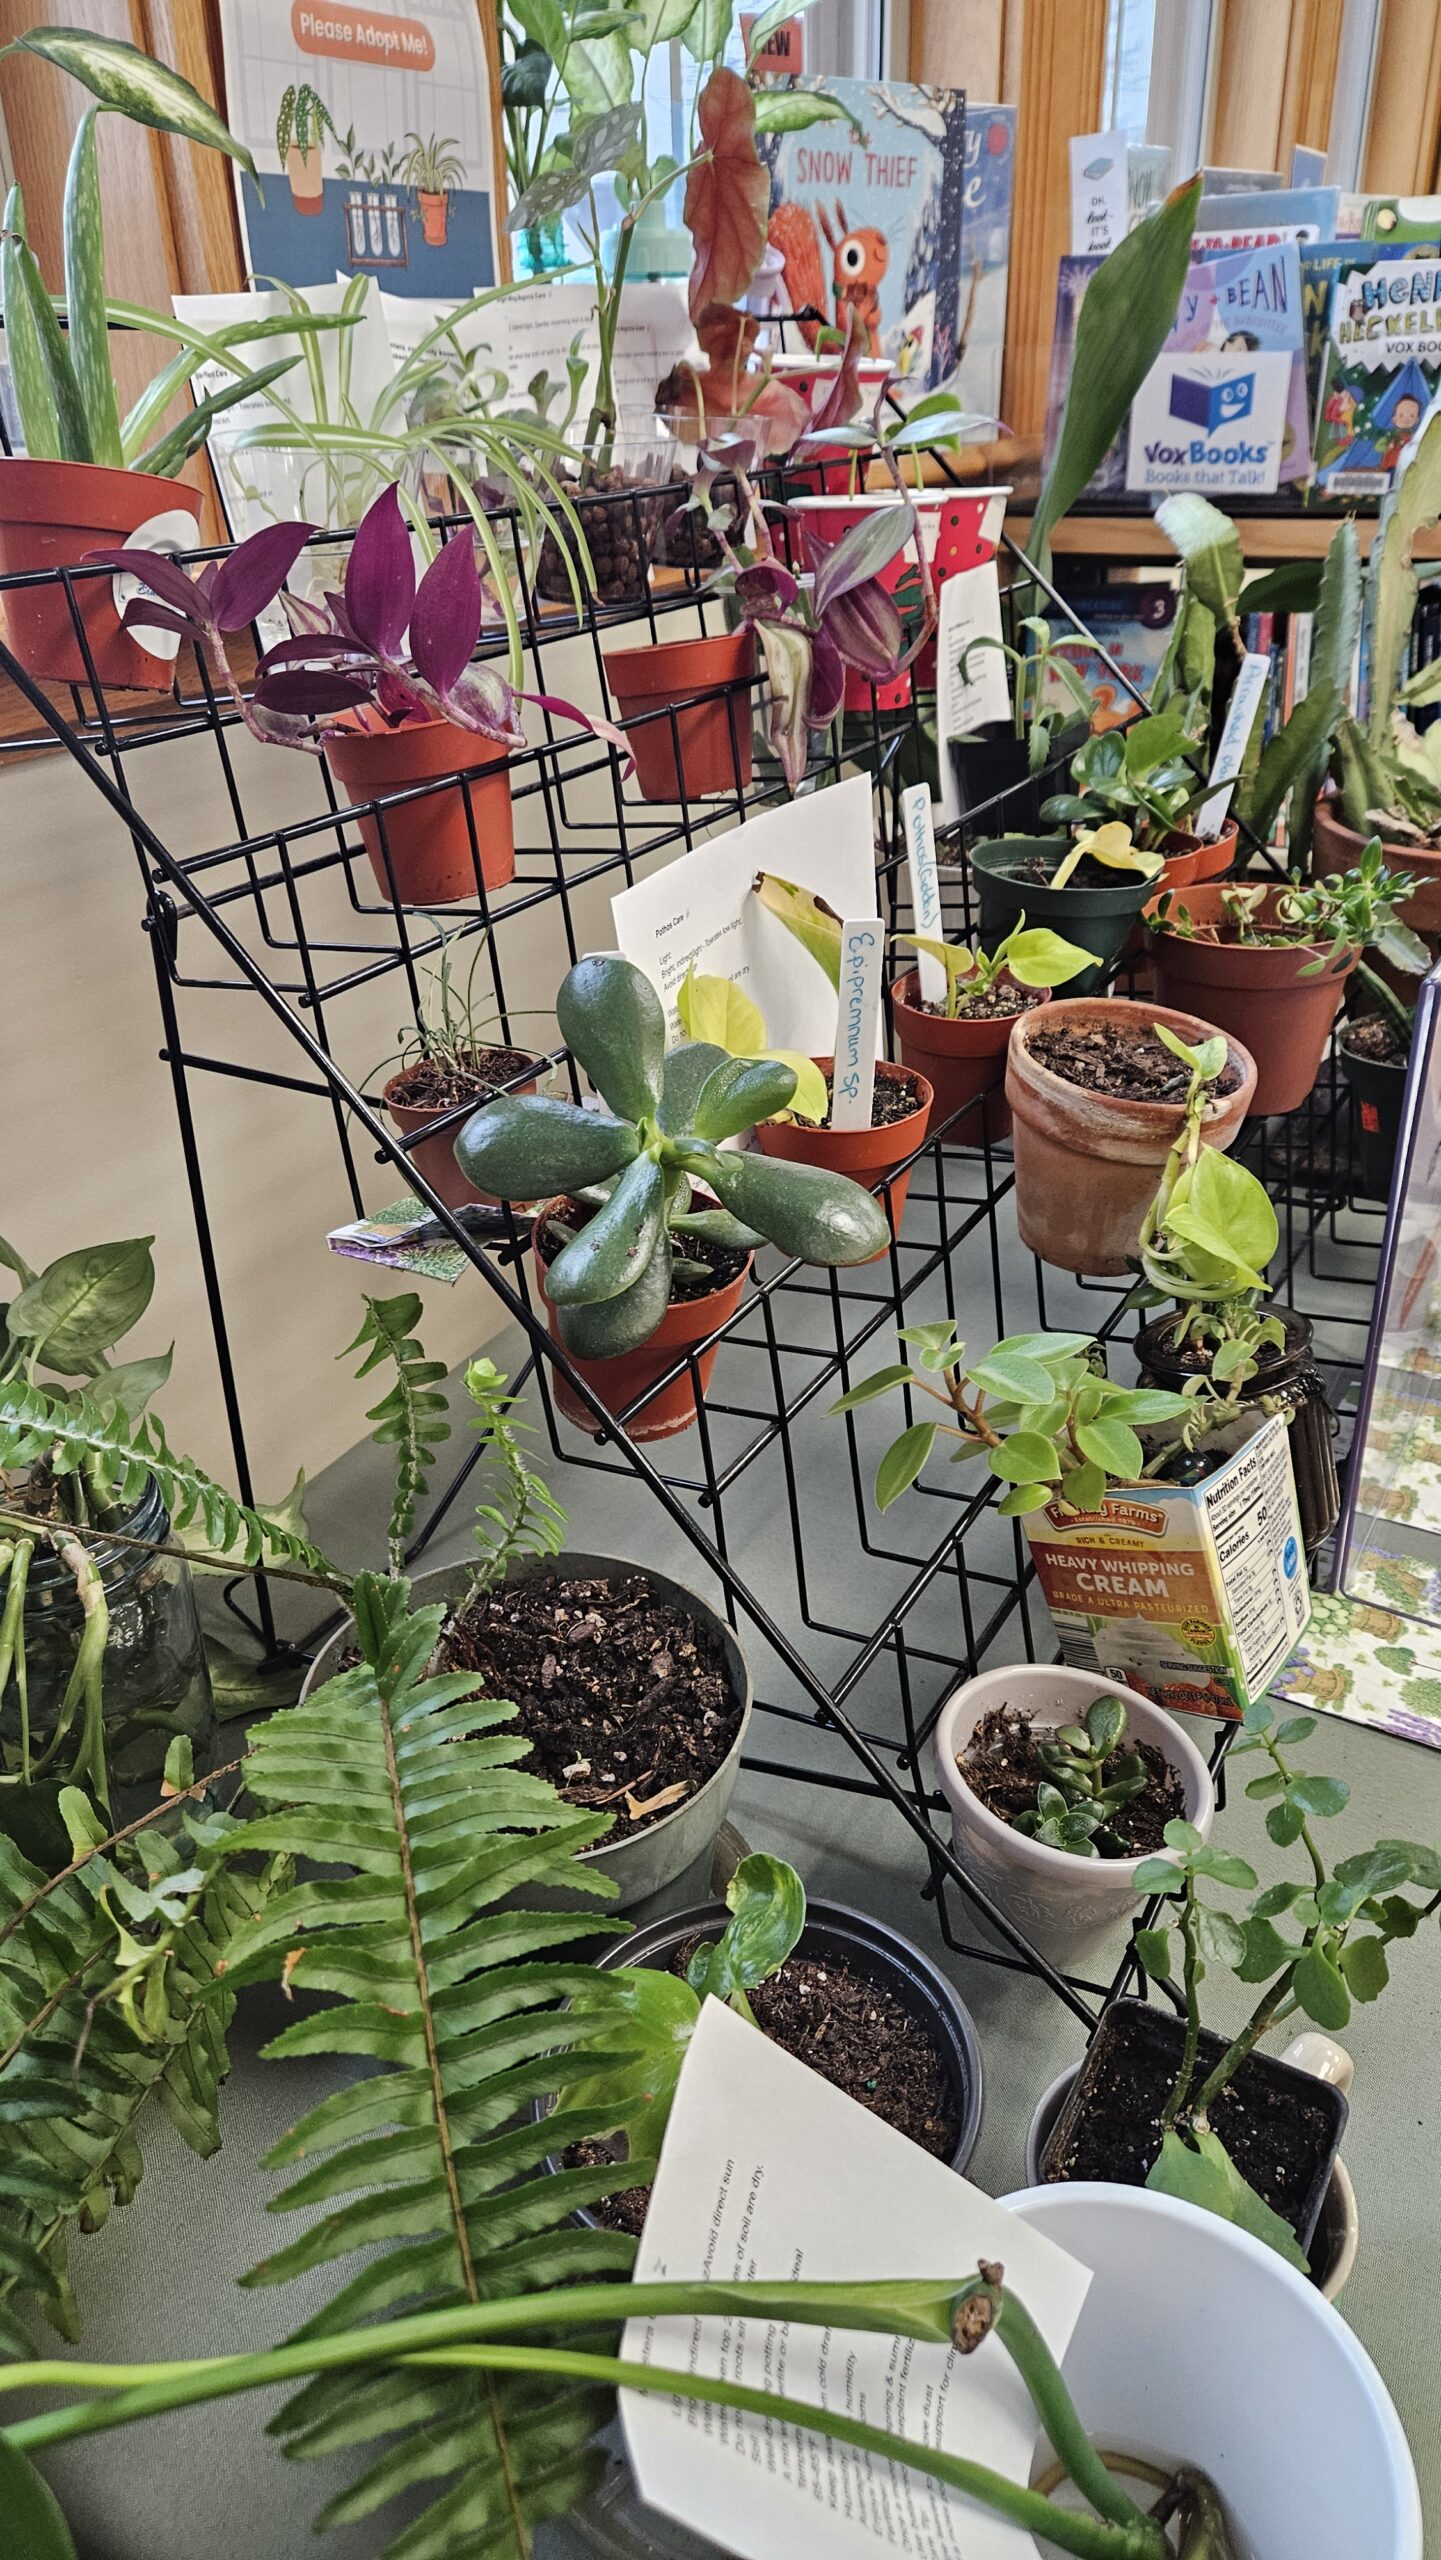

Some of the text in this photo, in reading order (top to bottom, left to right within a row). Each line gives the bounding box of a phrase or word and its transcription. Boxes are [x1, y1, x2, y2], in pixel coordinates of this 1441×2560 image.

[300, 12, 428, 56] Please Adopt Me!
[797, 147, 852, 186] SNOW
[865, 152, 918, 189] THIEF
[1227, 255, 1288, 314] BEAN
[1386, 341, 1414, 354] VOX
[1145, 469, 1266, 486] Books that Talk!
[1152, 599, 1166, 620] 3
[655, 914, 684, 939] Pothos Care
[1206, 1457, 1257, 1509] Nutrition Facts
[1111, 1503, 1158, 1522] Farms
[1213, 1517, 1227, 1531] Serving
[1076, 1536, 1096, 1545] RICH
[1108, 1537, 1145, 1548] CREAMY
[1219, 1531, 1250, 1562] Calories
[1255, 1505, 1269, 1526] 50
[1045, 1553, 1195, 1576] HEAVY WHIPPING
[1076, 1572, 1170, 1598] CREAM
[1053, 1590, 1083, 1603] GRADE
[1098, 1597, 1130, 1610] ULTRA
[1134, 1600, 1209, 1614] PASTEURIZED
[1110, 1669, 1124, 1680] 50
[750, 2164, 764, 2189] dry.
[712, 2186, 728, 2227] direct
[723, 2159, 735, 2185] sun
[746, 2191, 757, 2215] are
[740, 2215, 752, 2243] soil
[735, 2242, 746, 2260] of
[791, 2248, 804, 2281] deal
[719, 2329, 733, 2353] top
[763, 2324, 778, 2376] potting
[779, 2338, 788, 2356] or
[732, 2342, 745, 2381] roots
[819, 2357, 827, 2390] cold
[777, 2358, 786, 2396] erlite
[846, 2350, 858, 2413] humidity
[885, 2375, 894, 2386] &
[939, 2372, 950, 2394] for
[921, 2384, 934, 2418] dust
